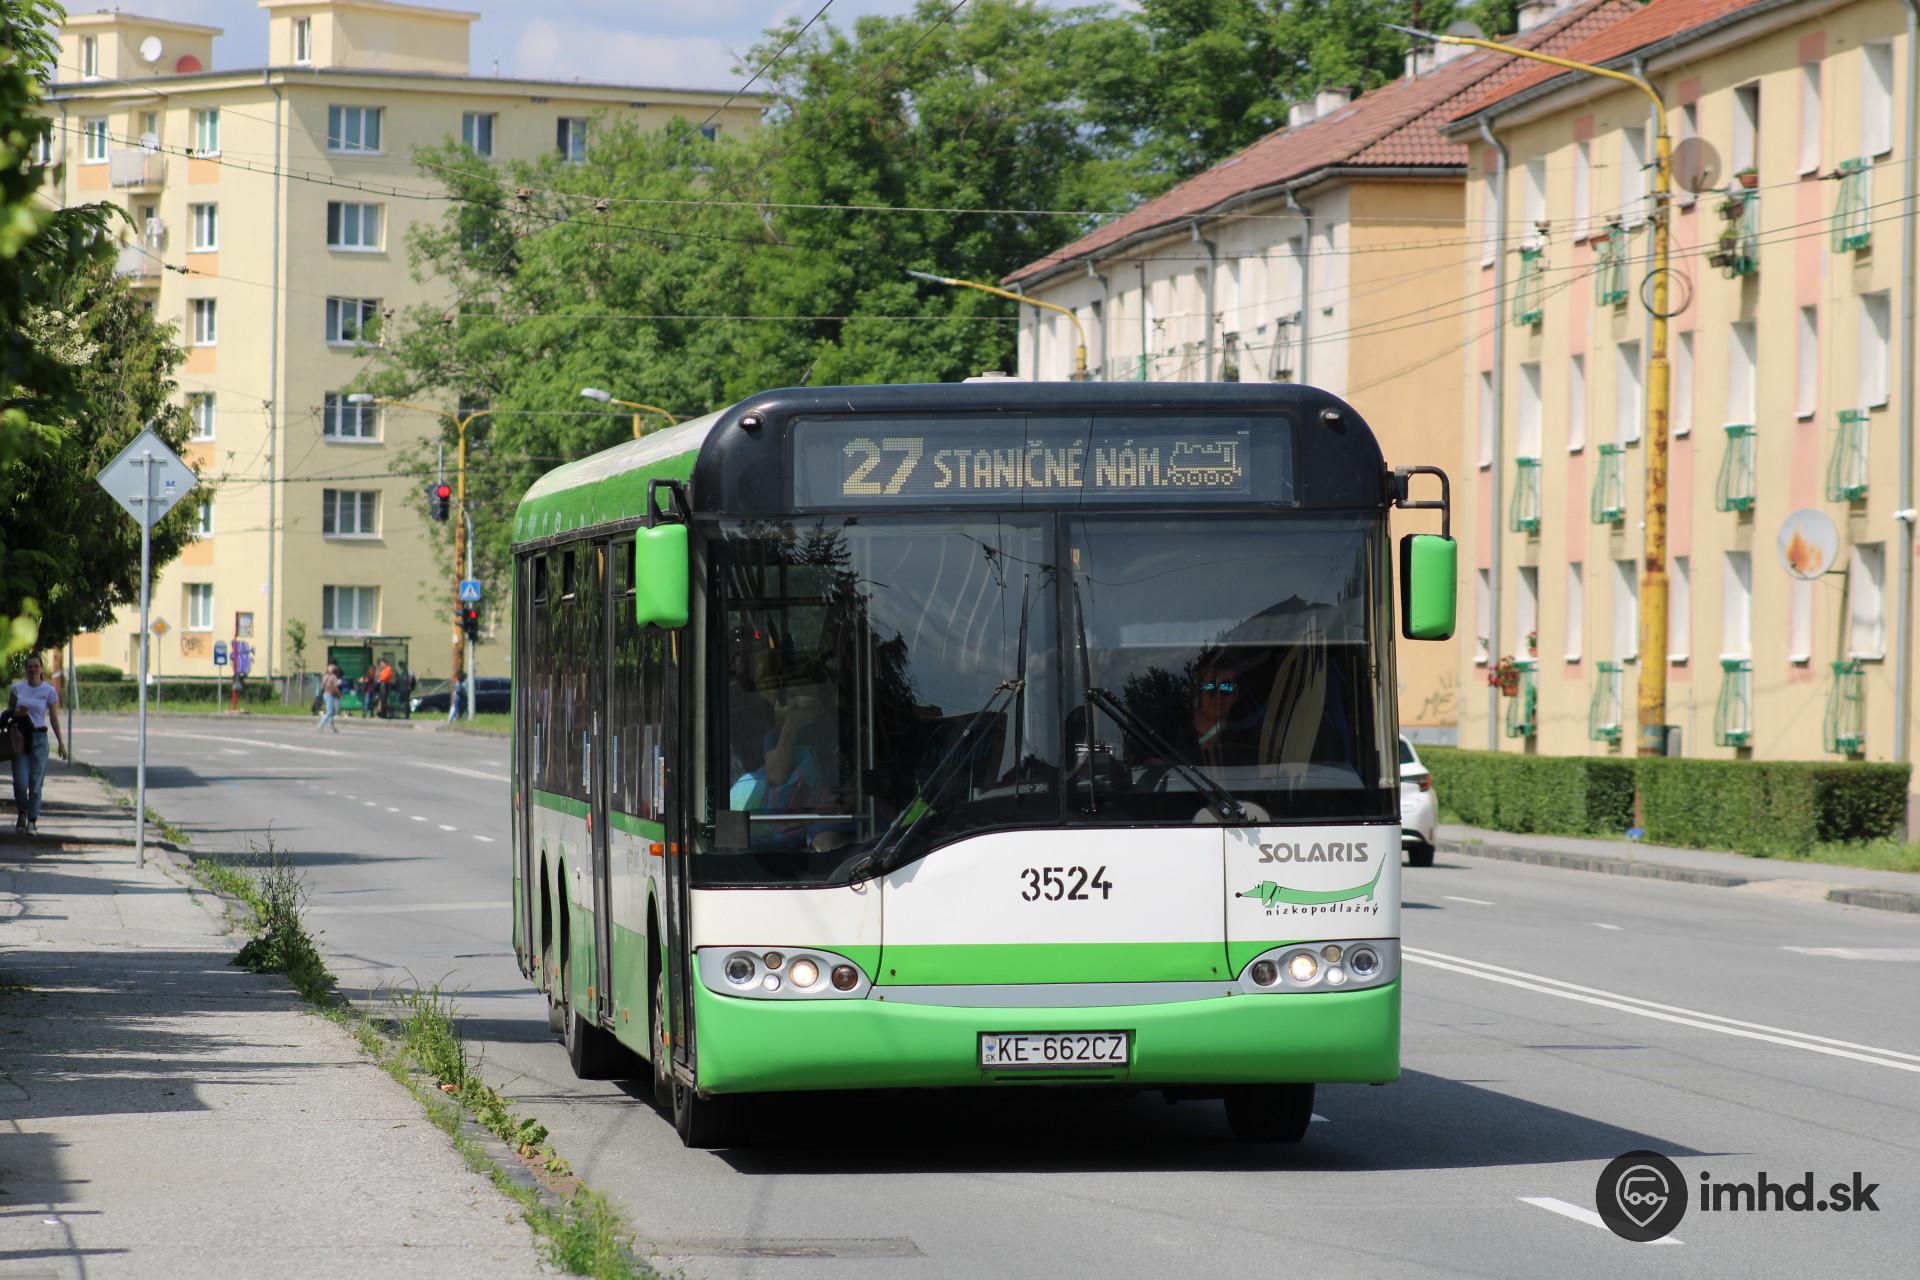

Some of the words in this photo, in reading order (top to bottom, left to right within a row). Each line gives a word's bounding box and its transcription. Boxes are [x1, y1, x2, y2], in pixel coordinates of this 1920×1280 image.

[842, 437, 924, 495] 27
[933, 439, 1083, 488] STANIČNÉ
[1095, 439, 1168, 487] NÁM.
[1258, 842, 1369, 864] SOLARIS
[1020, 865, 1113, 902] 3524
[1266, 902, 1379, 916] nízkopodlažný
[985, 1054, 997, 1062] SK
[998, 1036, 1123, 1062] KE-662CZ
